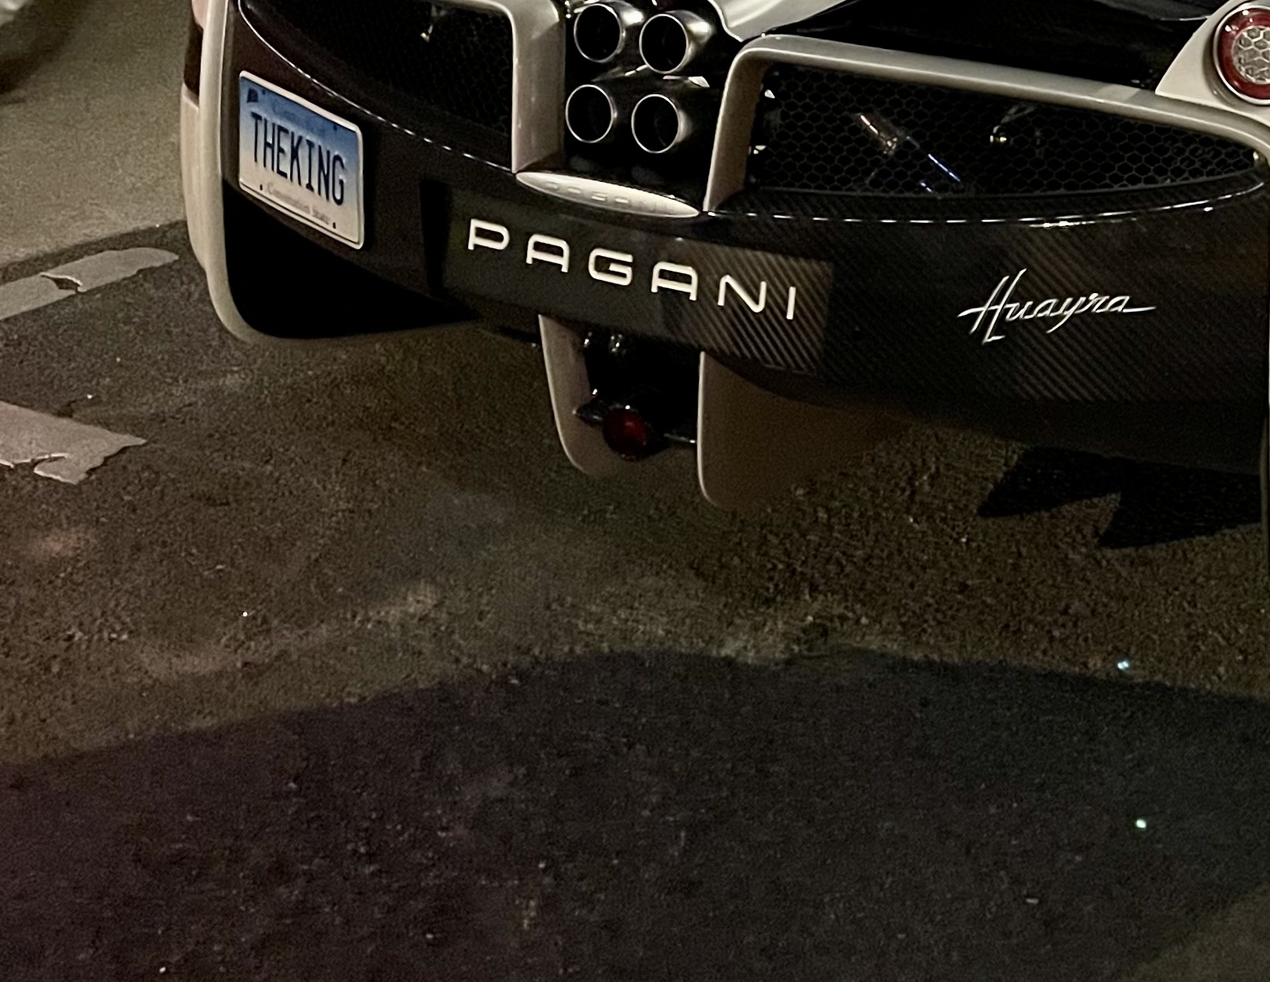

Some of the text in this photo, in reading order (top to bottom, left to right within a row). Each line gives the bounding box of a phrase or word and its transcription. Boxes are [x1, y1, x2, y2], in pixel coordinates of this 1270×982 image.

[250, 111, 346, 206] THEKING
[467, 218, 796, 320] PAGANI
[957, 268, 1156, 344] Huayra
